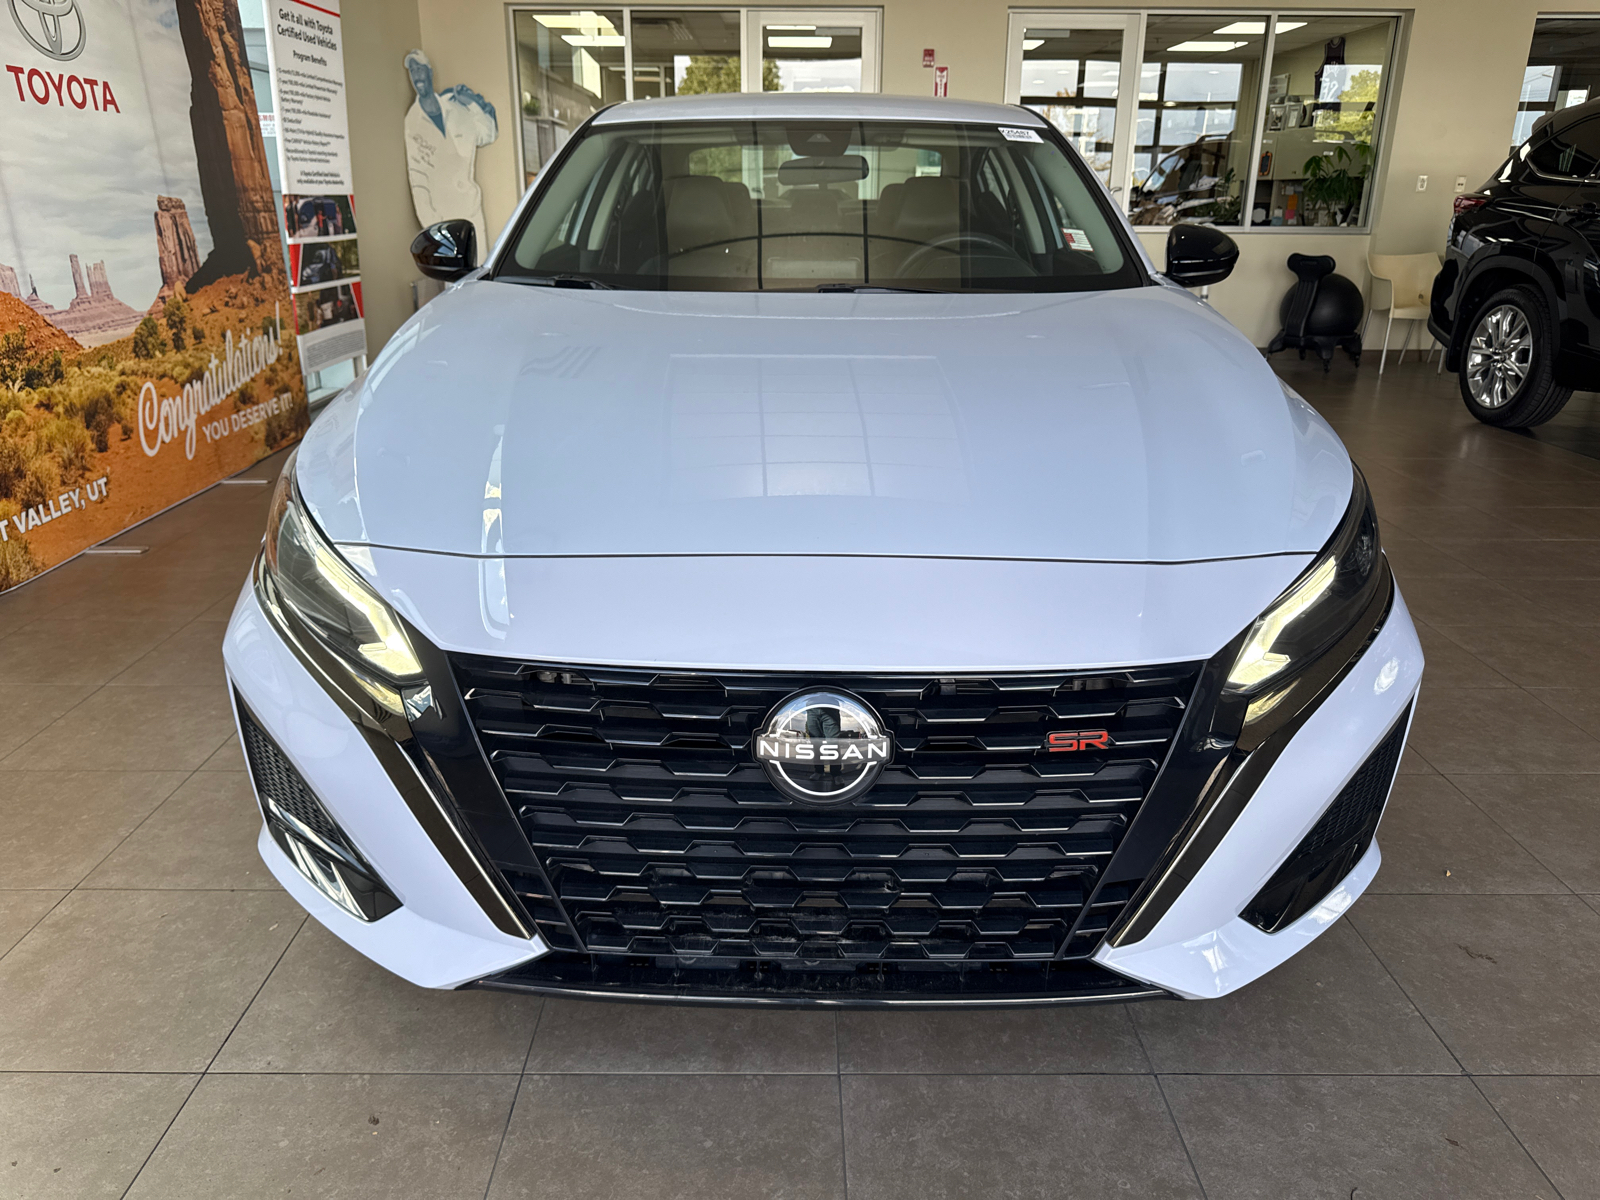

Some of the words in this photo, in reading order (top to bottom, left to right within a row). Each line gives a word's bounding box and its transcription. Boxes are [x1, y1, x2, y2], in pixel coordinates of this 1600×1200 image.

[279, 8, 290, 21] Get
[296, 14, 304, 26] all
[304, 17, 316, 30] with
[316, 20, 333, 35] Toyota
[277, 24, 302, 40] Certified
[302, 31, 316, 45] Used
[316, 35, 337, 51] Vehicles
[293, 50, 311, 62] Program
[311, 54, 327, 66] Benefits
[5, 64, 121, 114] TOYOTA
[138, 301, 284, 461] Congratulations!
[202, 419, 229, 443] YOU
[231, 397, 280, 432] DESERVE
[279, 391, 294, 413] IT!
[12, 488, 86, 534] VALLEY,
[86, 476, 108, 502] UT
[759, 740, 887, 760] NISSAN
[1048, 730, 1108, 752] SR
